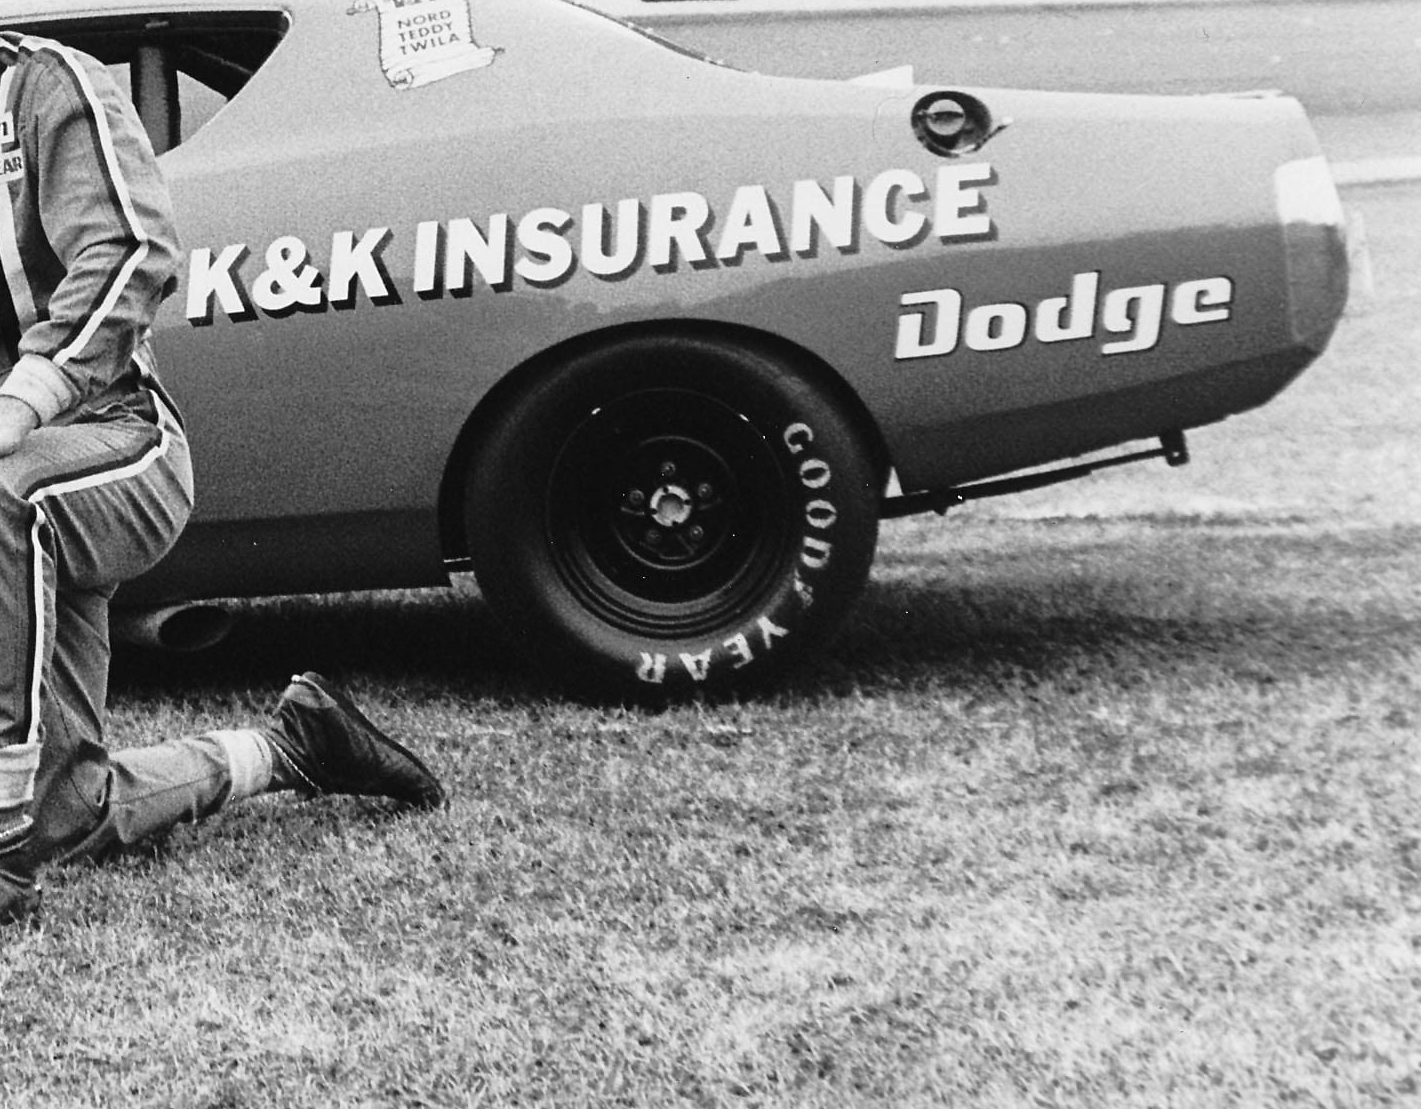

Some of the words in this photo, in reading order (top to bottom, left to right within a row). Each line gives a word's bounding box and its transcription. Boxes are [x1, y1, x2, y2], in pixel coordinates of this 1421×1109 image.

[398, 10, 452, 30] NORD
[399, 22, 453, 43] TEDDY
[400, 33, 461, 56] TWILA
[185, 226, 401, 327] K&K
[413, 162, 1000, 297] INSURANCE
[894, 270, 1233, 361] Dodge
